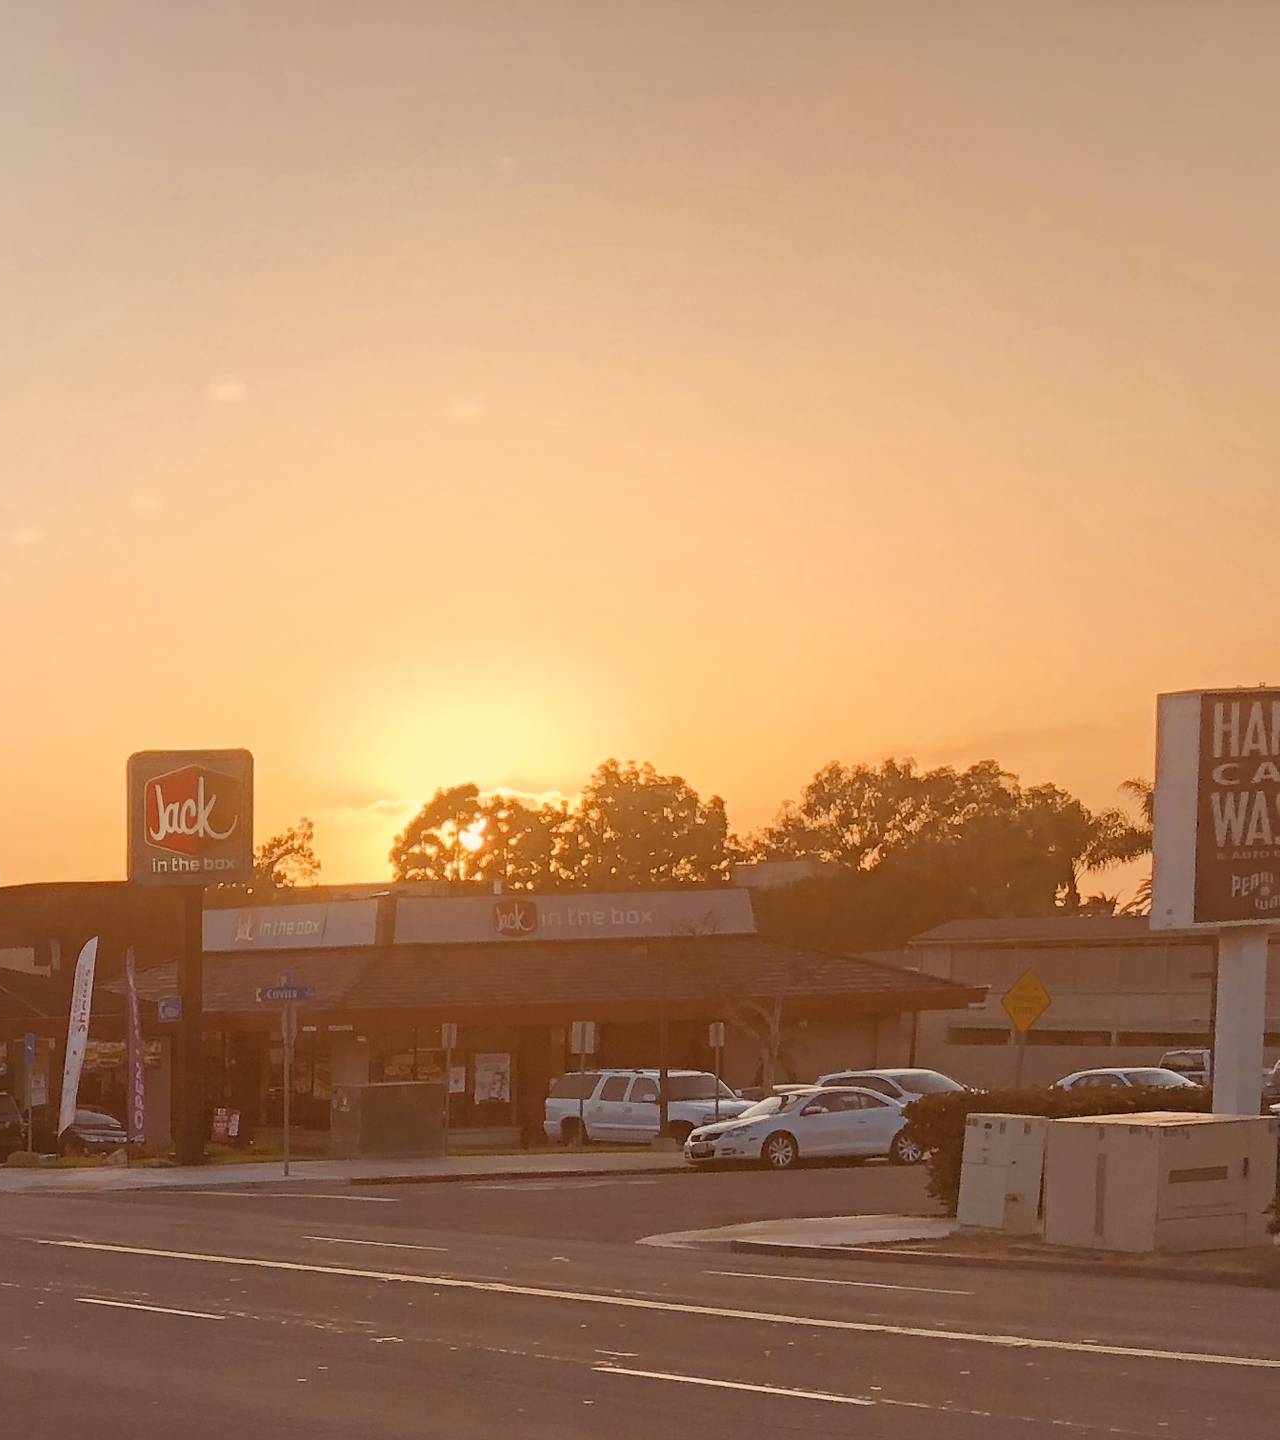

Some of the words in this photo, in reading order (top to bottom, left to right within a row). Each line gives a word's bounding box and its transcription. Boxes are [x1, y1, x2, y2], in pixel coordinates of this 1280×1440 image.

[149, 776, 238, 841] Jack
[152, 858, 167, 872] in
[172, 857, 200, 872] the
[204, 857, 235, 870] box
[273, 919, 294, 936] the
[296, 917, 320, 935] box
[496, 903, 535, 931] Jack
[542, 909, 561, 927] in
[567, 907, 607, 927] the
[611, 907, 653, 925] box
